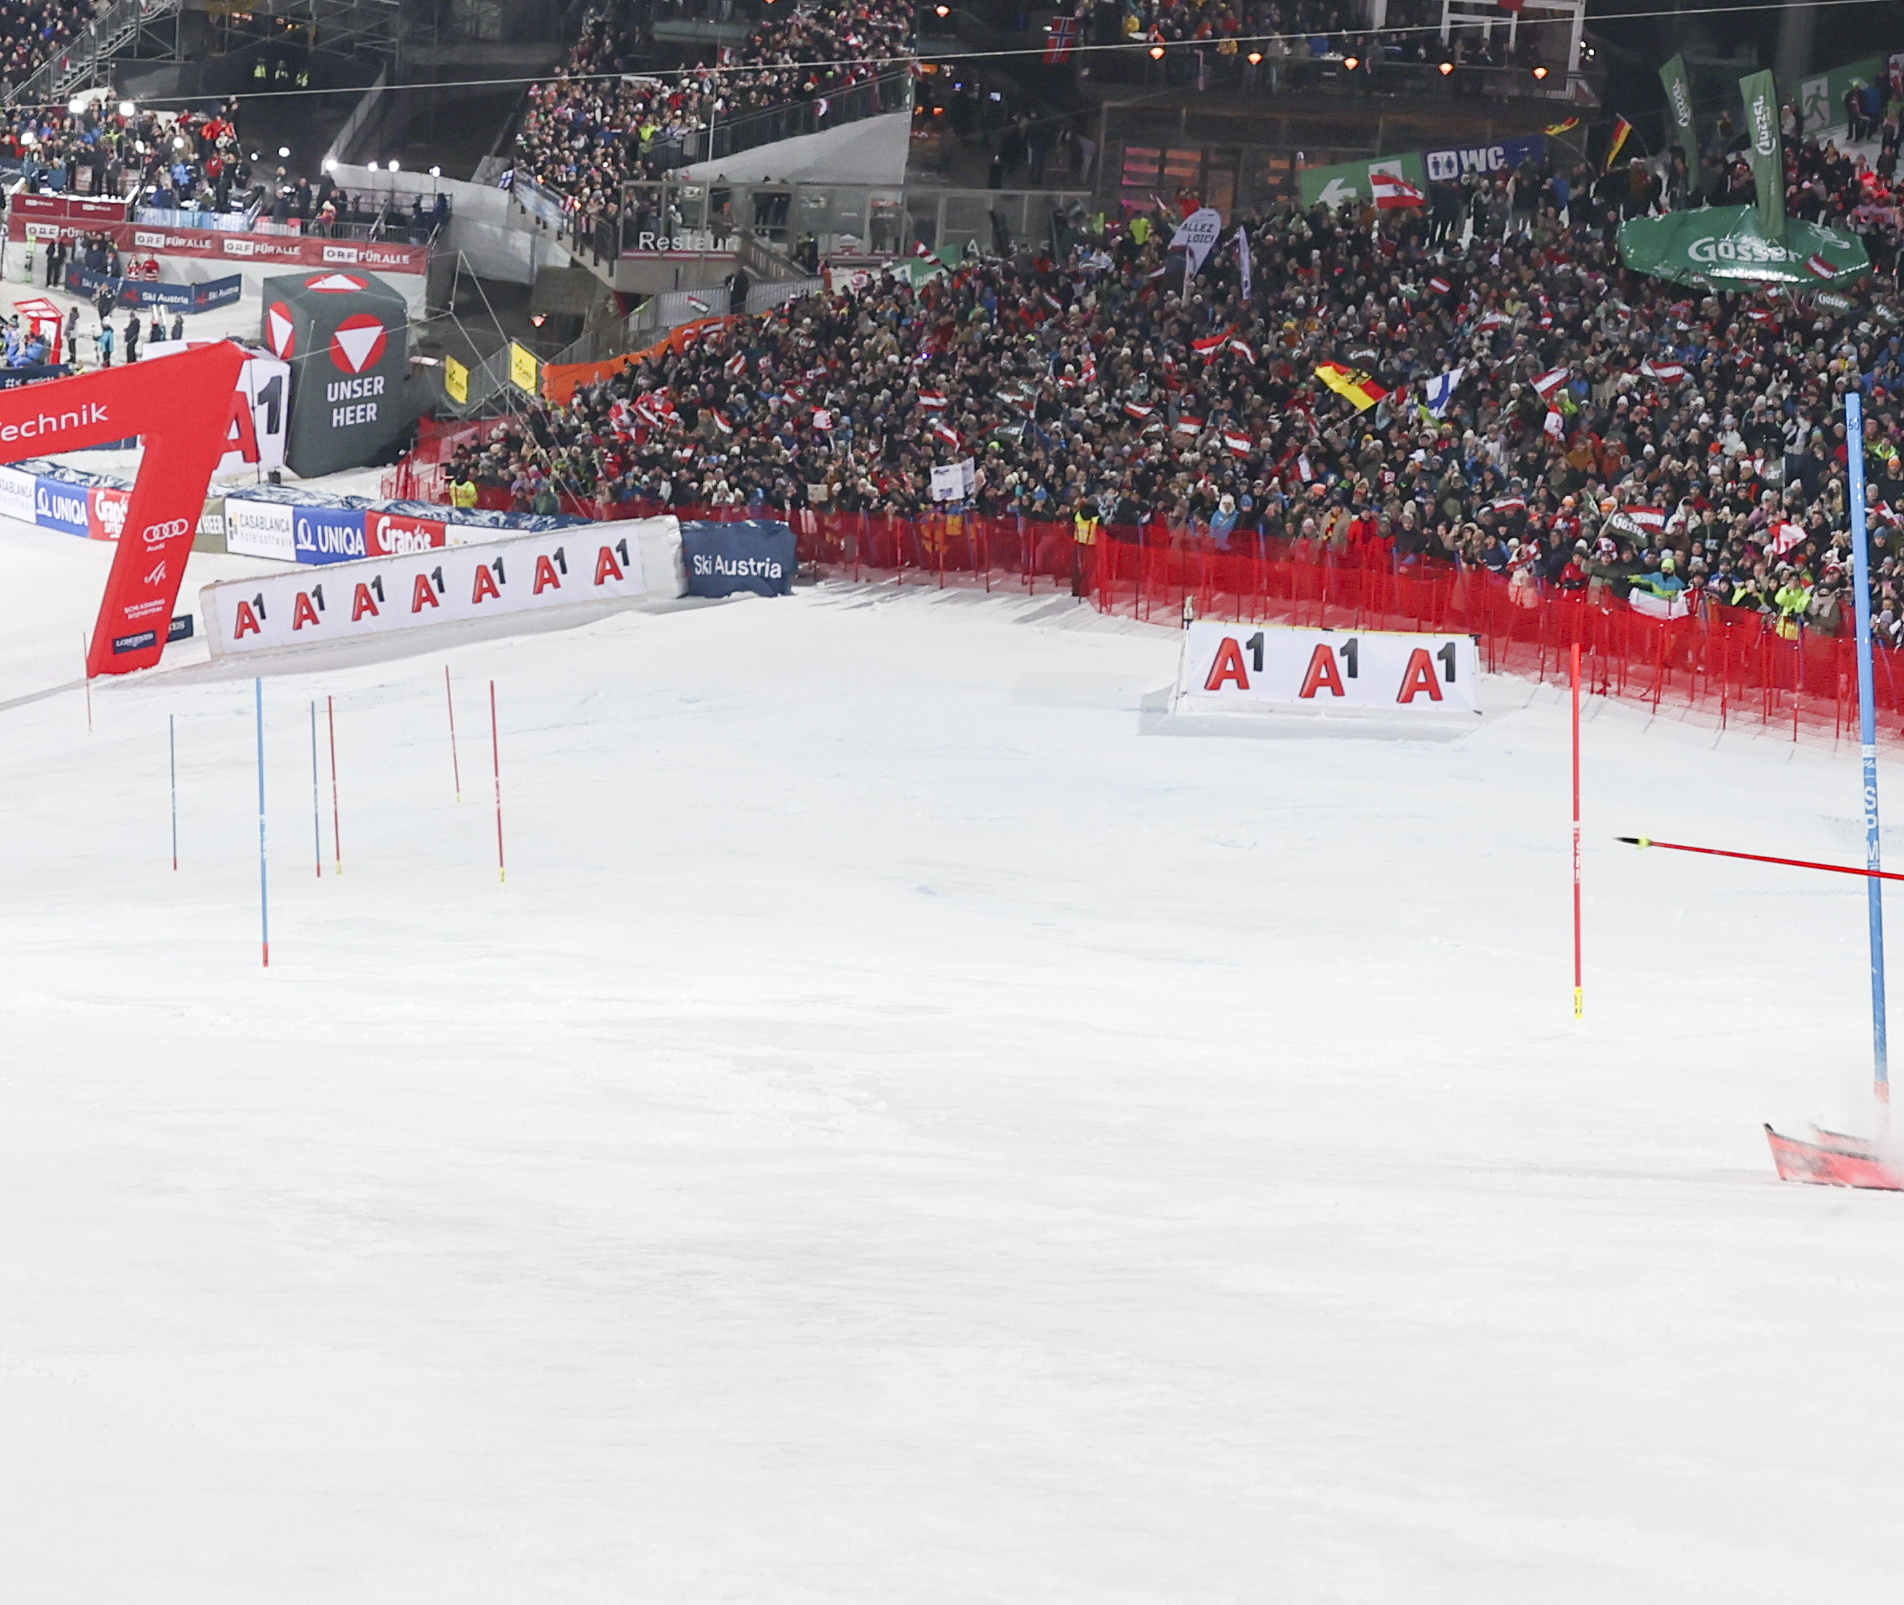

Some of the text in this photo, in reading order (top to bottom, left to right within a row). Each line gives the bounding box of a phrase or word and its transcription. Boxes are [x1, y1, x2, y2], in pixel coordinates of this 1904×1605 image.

[1460, 146, 1506, 172] WC
[1180, 223, 1215, 233] ALLEZ
[137, 234, 211, 249] ORF FÜR ALLE
[226, 242, 302, 256] ORF FÜR ALLE
[325, 249, 410, 264] ORF FÜR ALLE
[142, 292, 189, 305] Ski Austria
[327, 375, 385, 402] UNSER
[332, 403, 377, 428] HEER
[53, 495, 89, 527] UNIQA
[239, 513, 293, 533] CASABLANCA
[317, 525, 366, 556] UNIQA
[693, 554, 782, 579] Ski Austria
[234, 538, 629, 639] A1 A1 A1 A1 A1 A1 A1
[1203, 632, 1457, 703] A1 A1 A1
